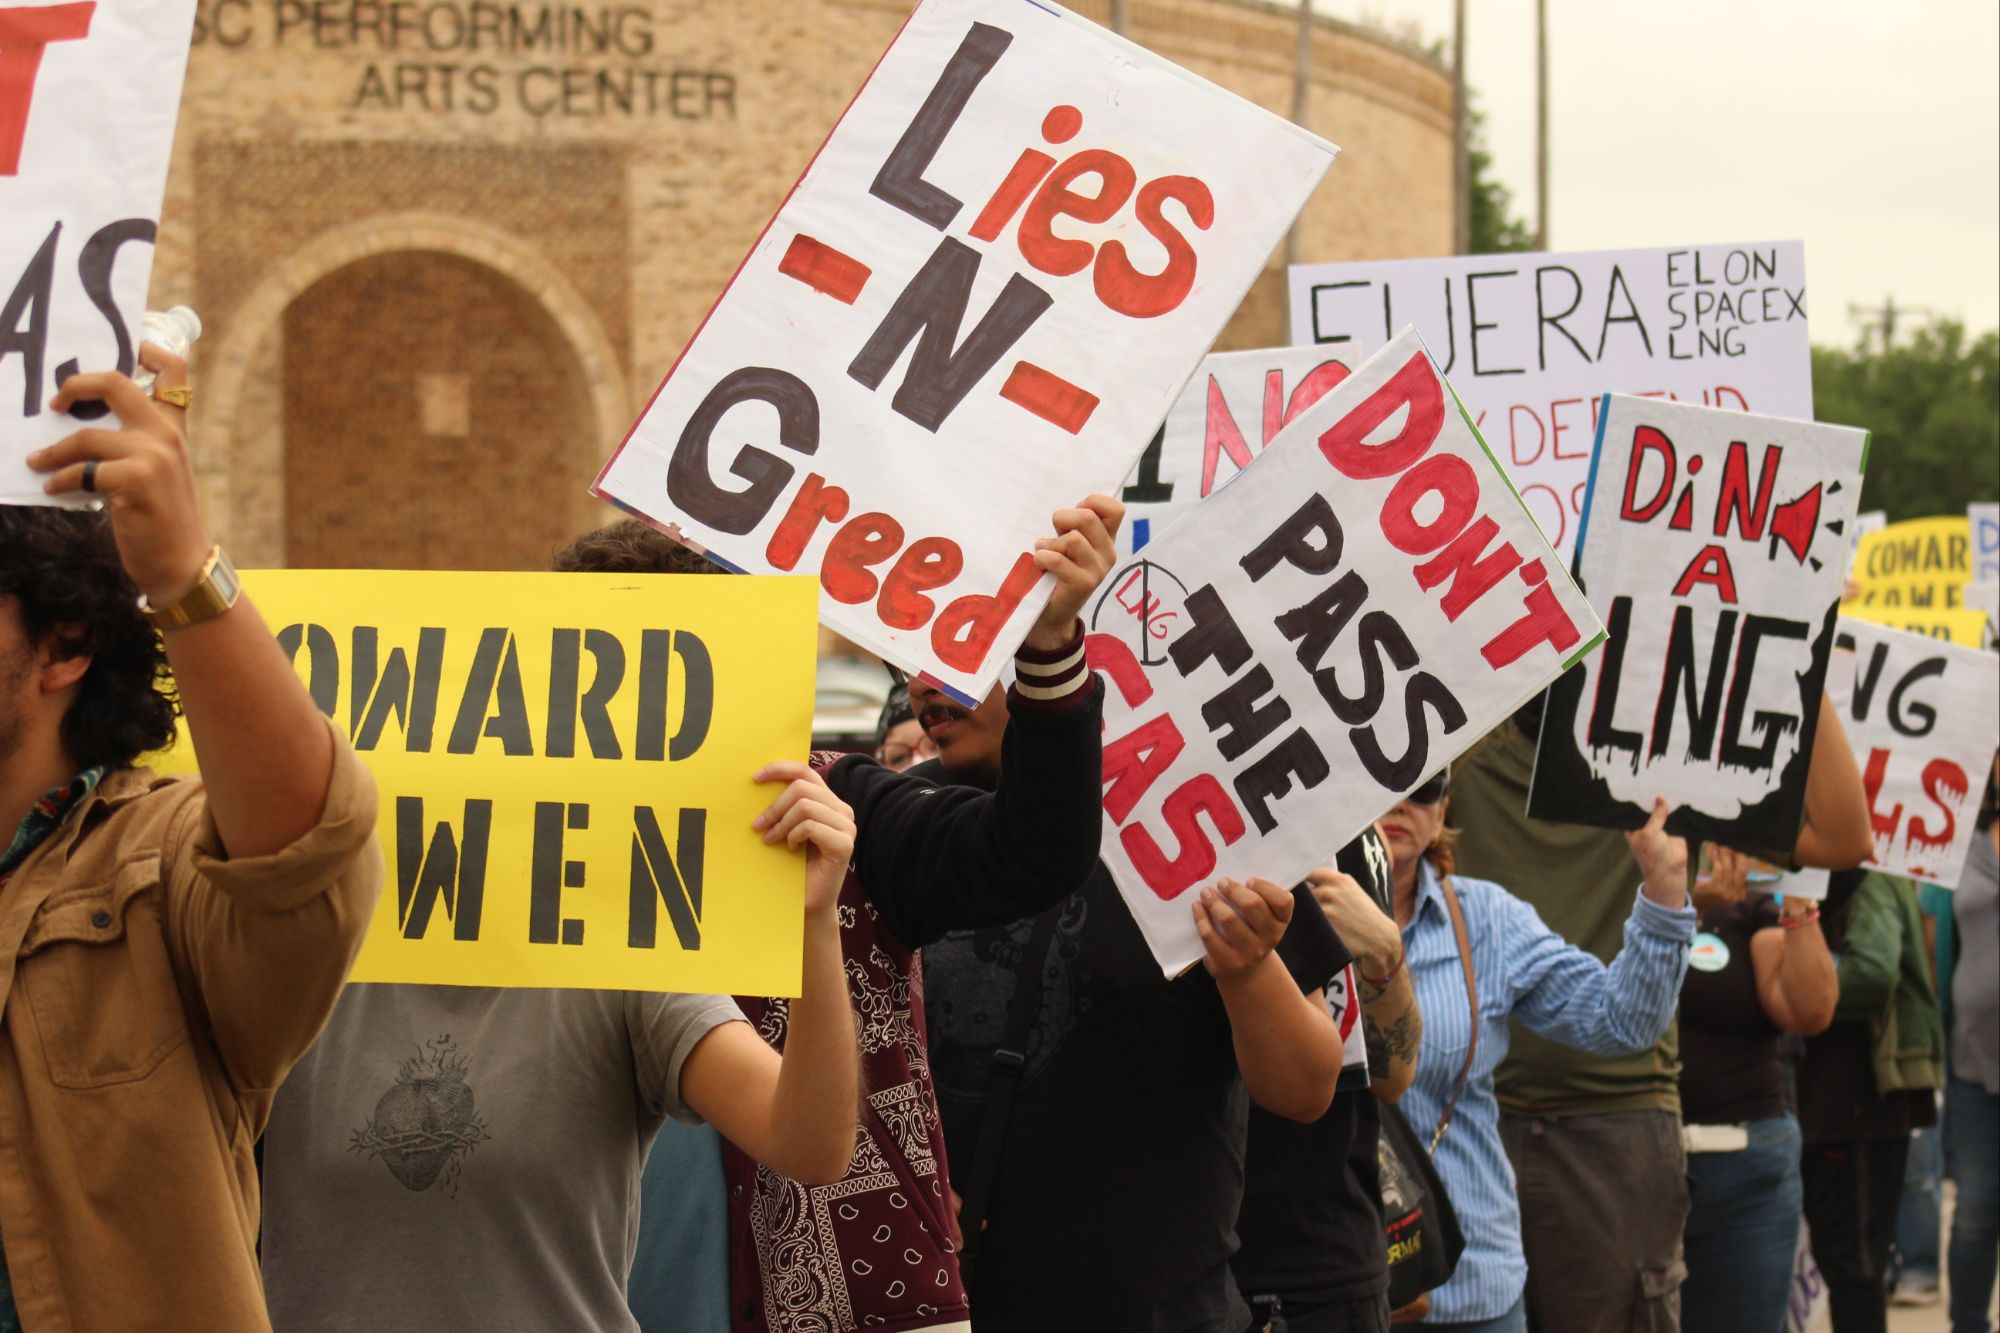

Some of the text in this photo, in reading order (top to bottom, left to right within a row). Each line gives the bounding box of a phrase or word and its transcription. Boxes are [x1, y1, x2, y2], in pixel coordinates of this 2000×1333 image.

[273, 0, 655, 57] PERFORMING
[354, 62, 738, 120] ARTS CENTER
[868, 21, 1215, 319] Lies
[1311, 264, 1654, 376] FUERA
[1667, 249, 1776, 287] ELON
[1667, 287, 1807, 331] SPACEX
[1668, 326, 1747, 360] LNG
[666, 366, 1048, 674] Greed
[1317, 349, 1582, 671] DON'T
[1866, 534, 1968, 579] COWAR
[1115, 568, 1178, 640] LNG
[1672, 544, 1738, 605] A
[273, 622, 715, 762] OWARD
[1238, 491, 1468, 793] PASS
[1586, 595, 1810, 780] LNG
[1167, 582, 1330, 837] THE
[396, 795, 708, 951] WEN
